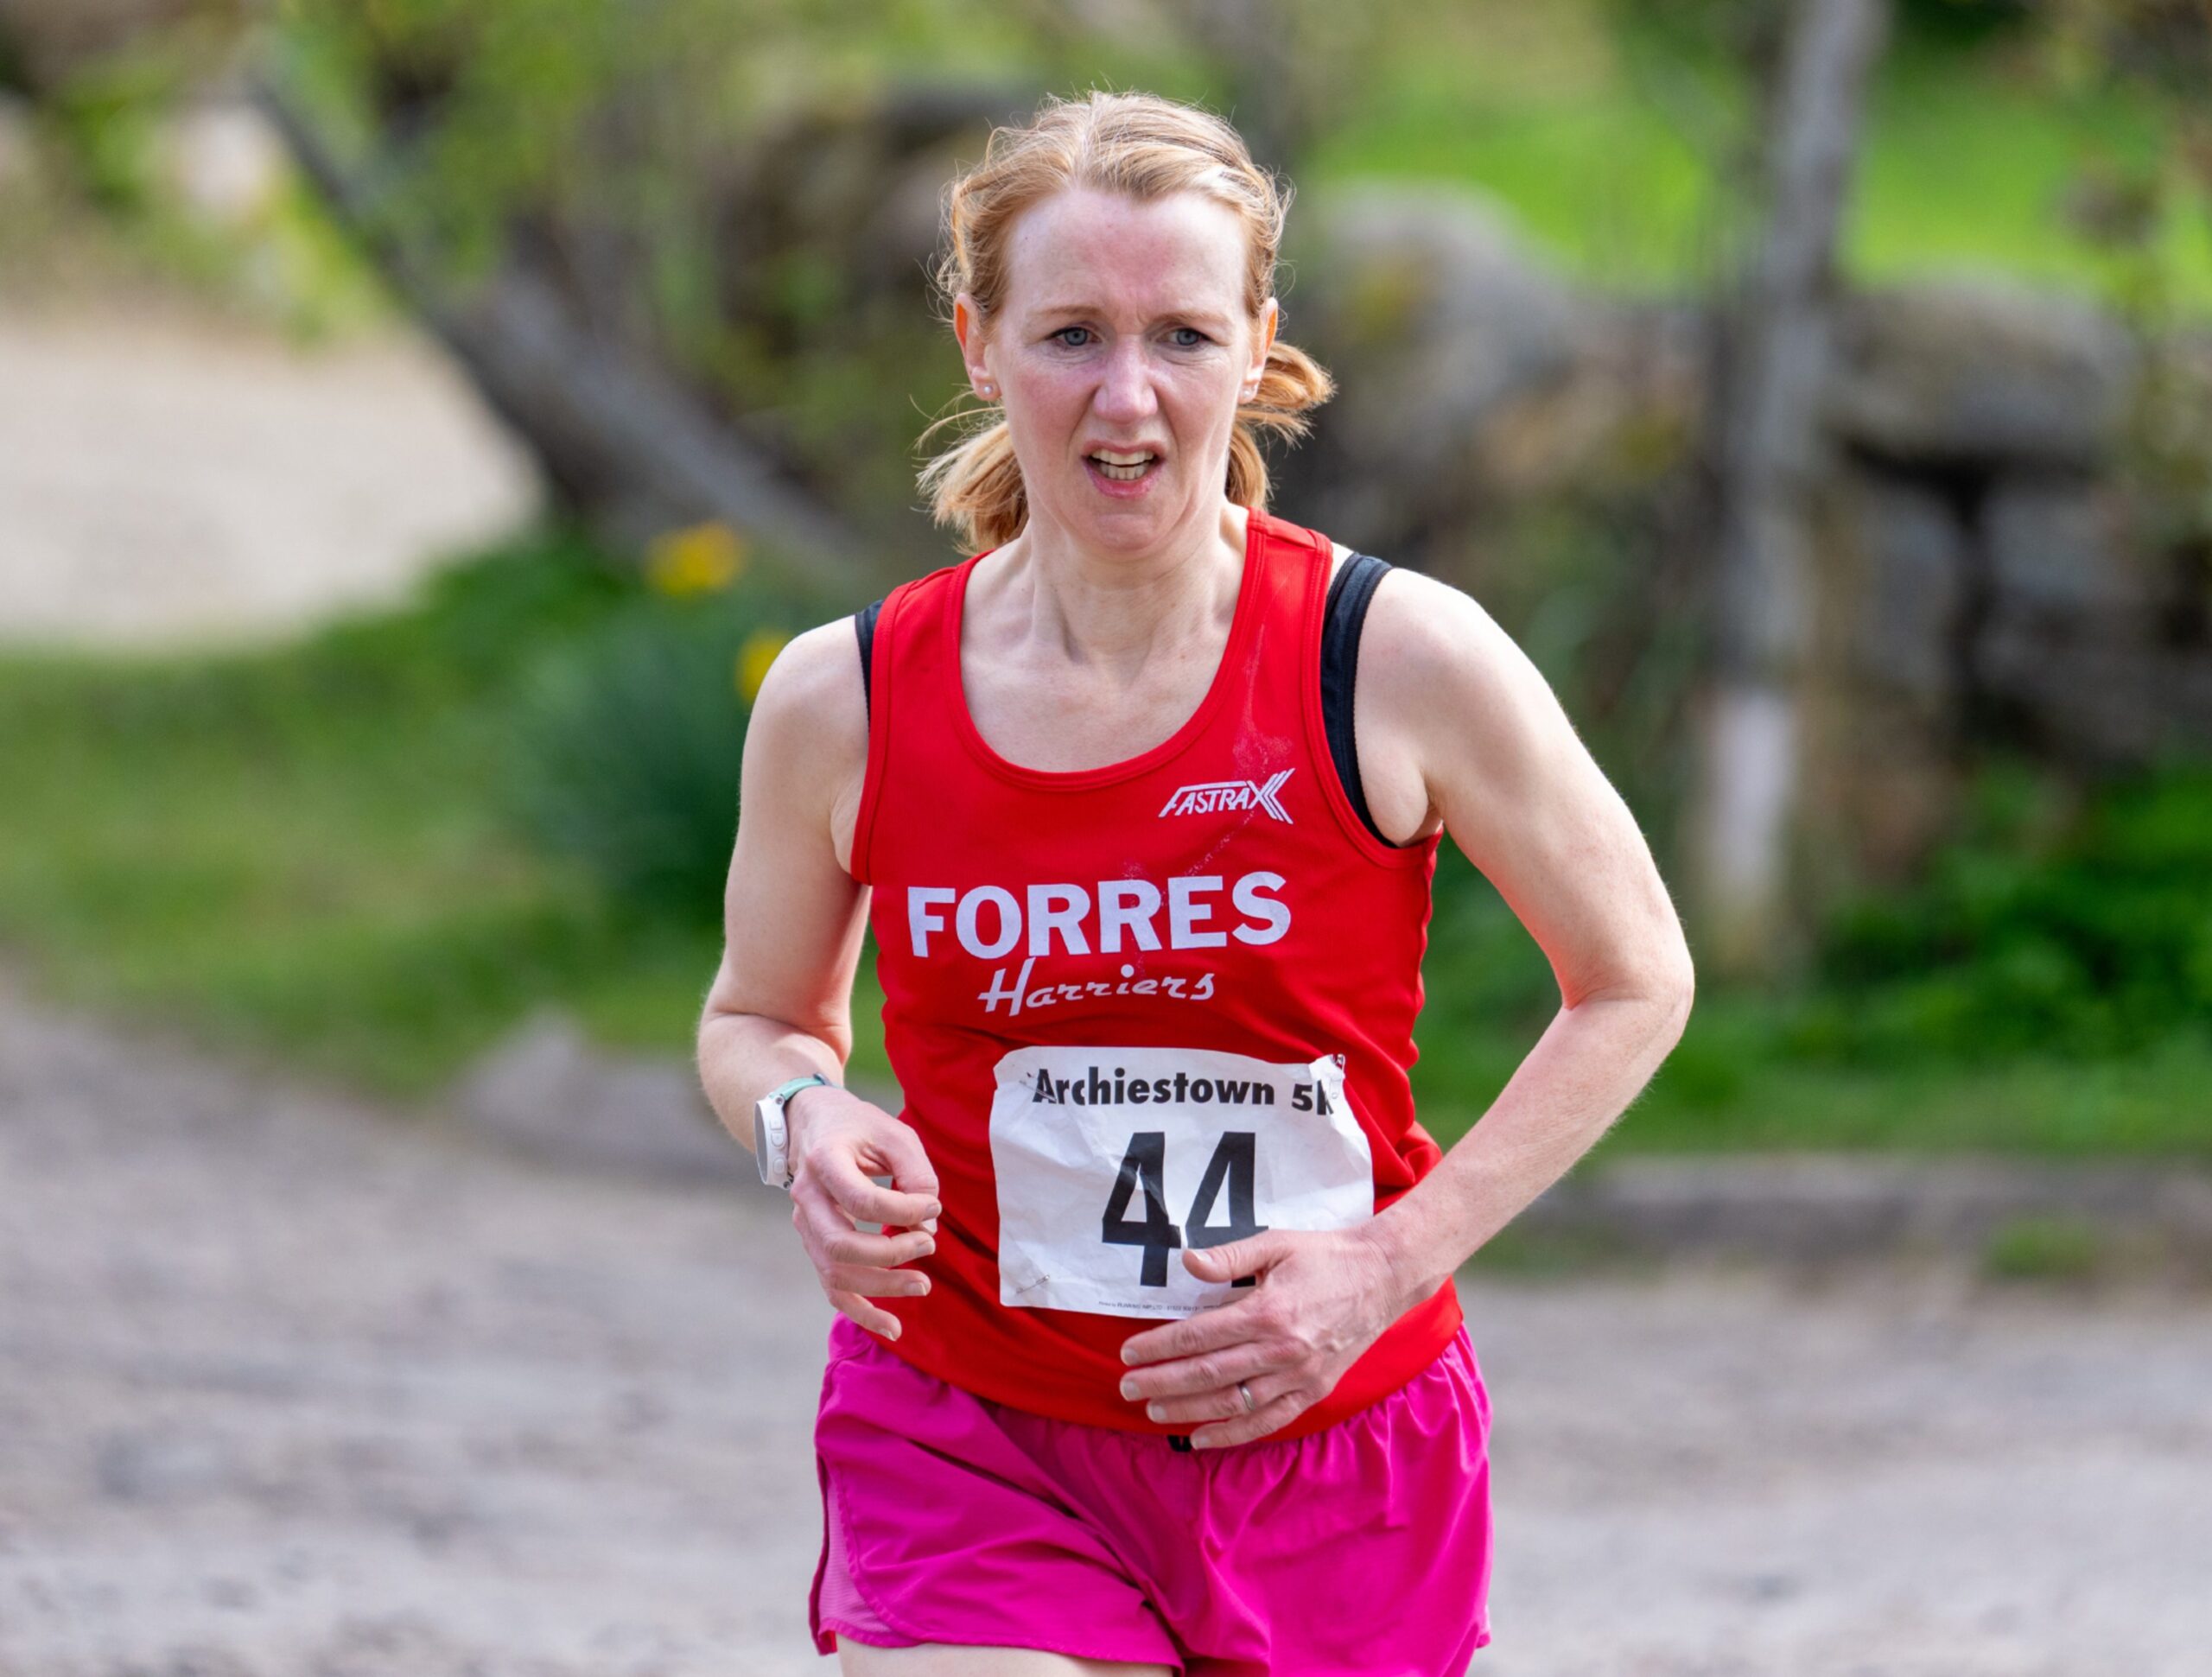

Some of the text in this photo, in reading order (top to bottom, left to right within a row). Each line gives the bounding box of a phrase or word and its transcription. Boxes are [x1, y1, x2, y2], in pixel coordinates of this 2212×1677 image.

[1158, 767, 1295, 825] FASTRAX
[907, 871, 1292, 959] FORRES
[977, 957, 1214, 1016] Harriers
[1033, 1066, 1274, 1106] Archiestown
[1102, 1131, 1269, 1288] 44
